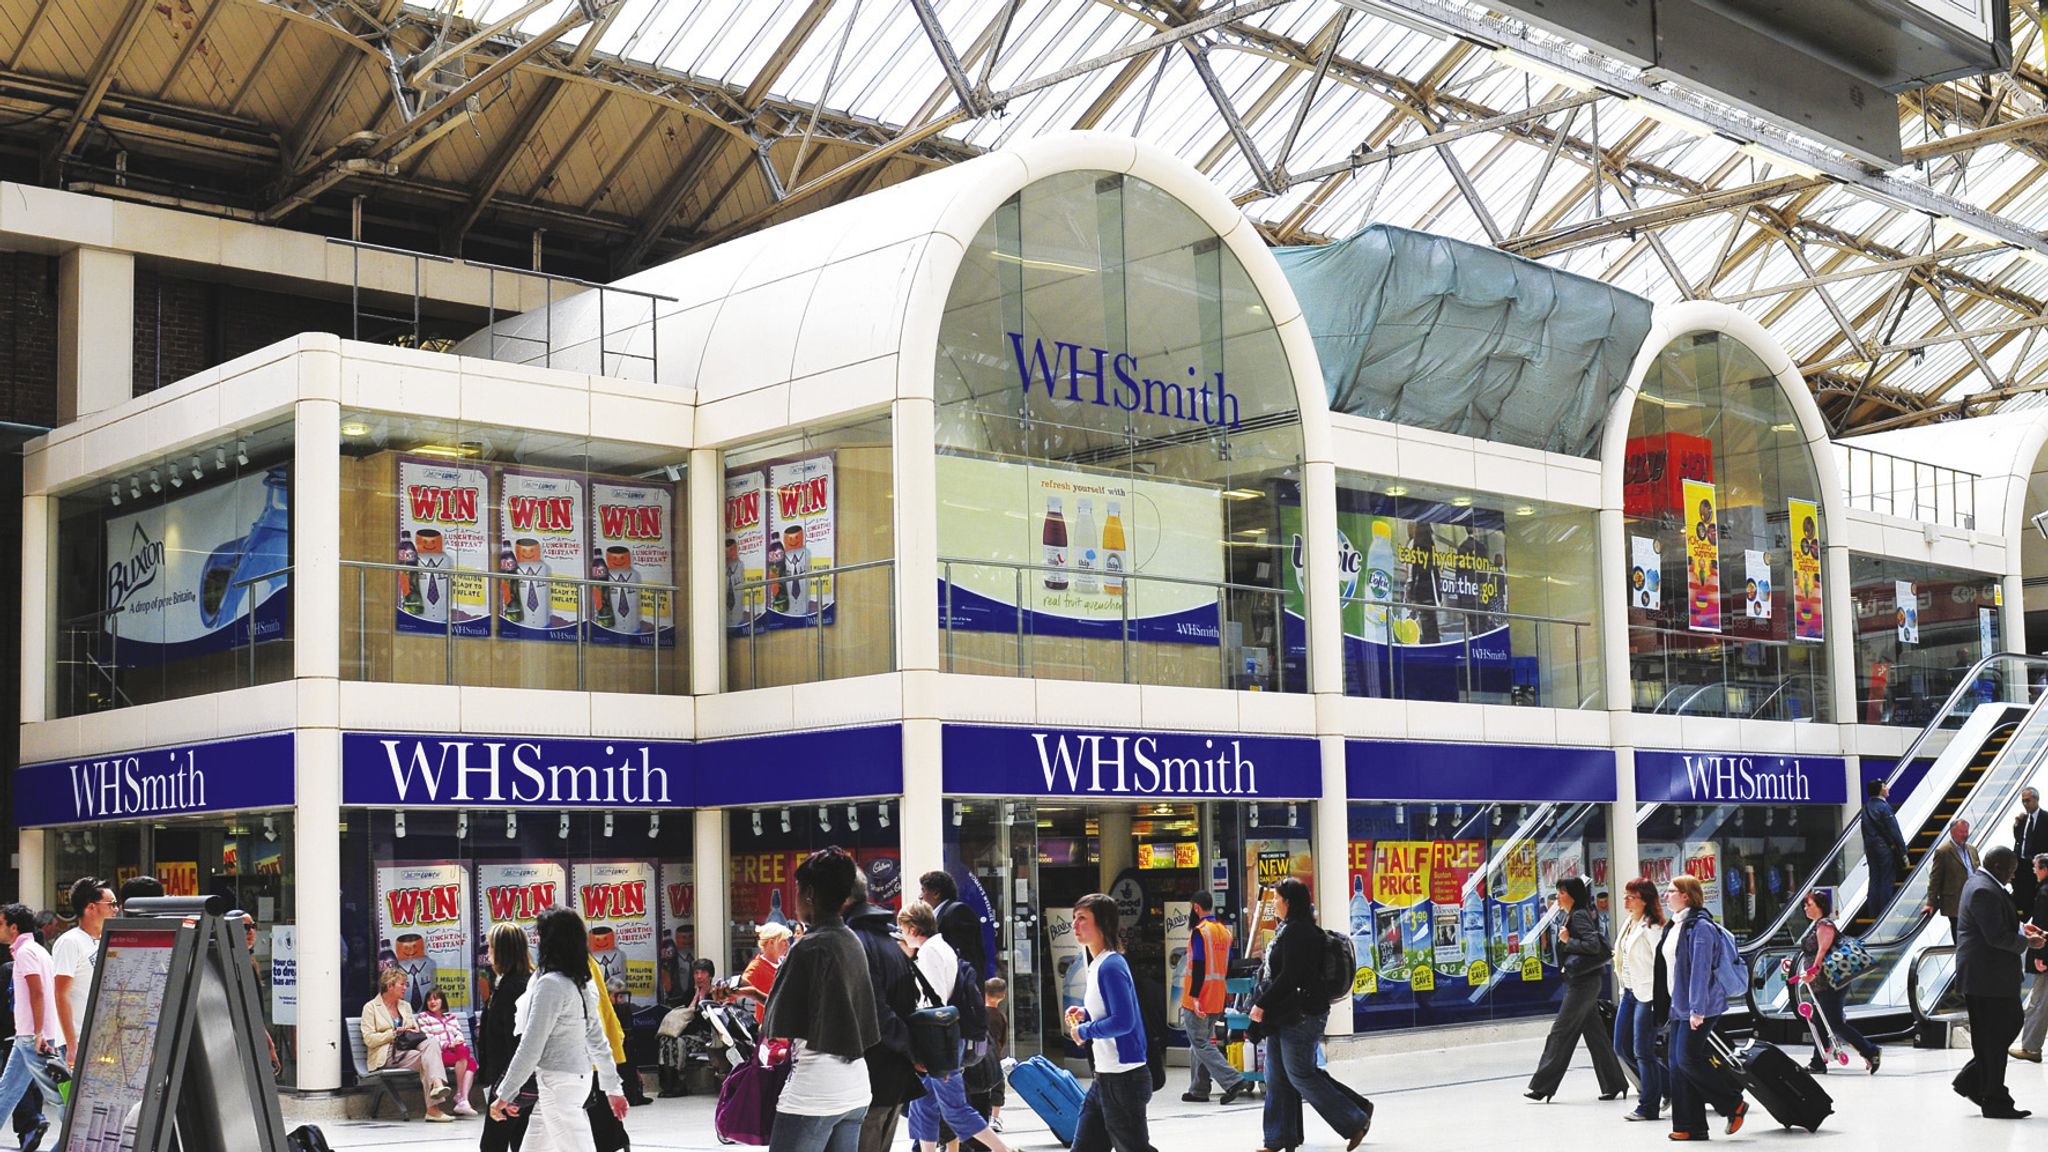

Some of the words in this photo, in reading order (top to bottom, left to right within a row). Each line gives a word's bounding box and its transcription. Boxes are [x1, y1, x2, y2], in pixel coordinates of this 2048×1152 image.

[1007, 332, 1242, 429] WHSmith
[779, 475, 827, 519] WIN
[1041, 480, 1071, 490] refresh
[1072, 484, 1105, 495] yourself
[1108, 488, 1125, 497] with
[409, 486, 477, 522] WIN
[509, 496, 574, 531] WIN
[600, 506, 662, 540] WIN
[1398, 544, 1429, 570] tasty
[1432, 546, 1498, 572] hydration...
[107, 540, 166, 620] Buxton
[1442, 580, 1455, 592] on
[1458, 576, 1478, 595] the
[1482, 576, 1498, 604] go!
[135, 601, 150, 615] drop
[1043, 596, 1060, 607] real
[1064, 592, 1081, 608] fruit
[1177, 622, 1219, 638] WHSmith
[1472, 648, 1507, 660] WHSmith
[379, 740, 672, 805] WHSmith
[1032, 734, 1259, 796] WHSmith
[1682, 755, 1811, 801] WHSmith
[69, 751, 207, 819] WHSmith
[731, 854, 786, 883] FREE
[1259, 859, 1289, 875] NEW
[1376, 847, 1430, 874] HALF
[1434, 842, 1480, 868] FREE
[1685, 855, 1716, 882] WIN
[158, 868, 197, 897] HALF
[1640, 858, 1674, 884] WIN
[1380, 875, 1423, 896] PRICE
[387, 885, 459, 925] WIN
[488, 883, 554, 919] WIN
[581, 881, 646, 919] WIN
[273, 966, 281, 976] to
[273, 977, 284, 986] has
[1415, 976, 1431, 986] SAVE
[1471, 971, 1487, 980] SAVE
[1524, 968, 1540, 976] SAVE
